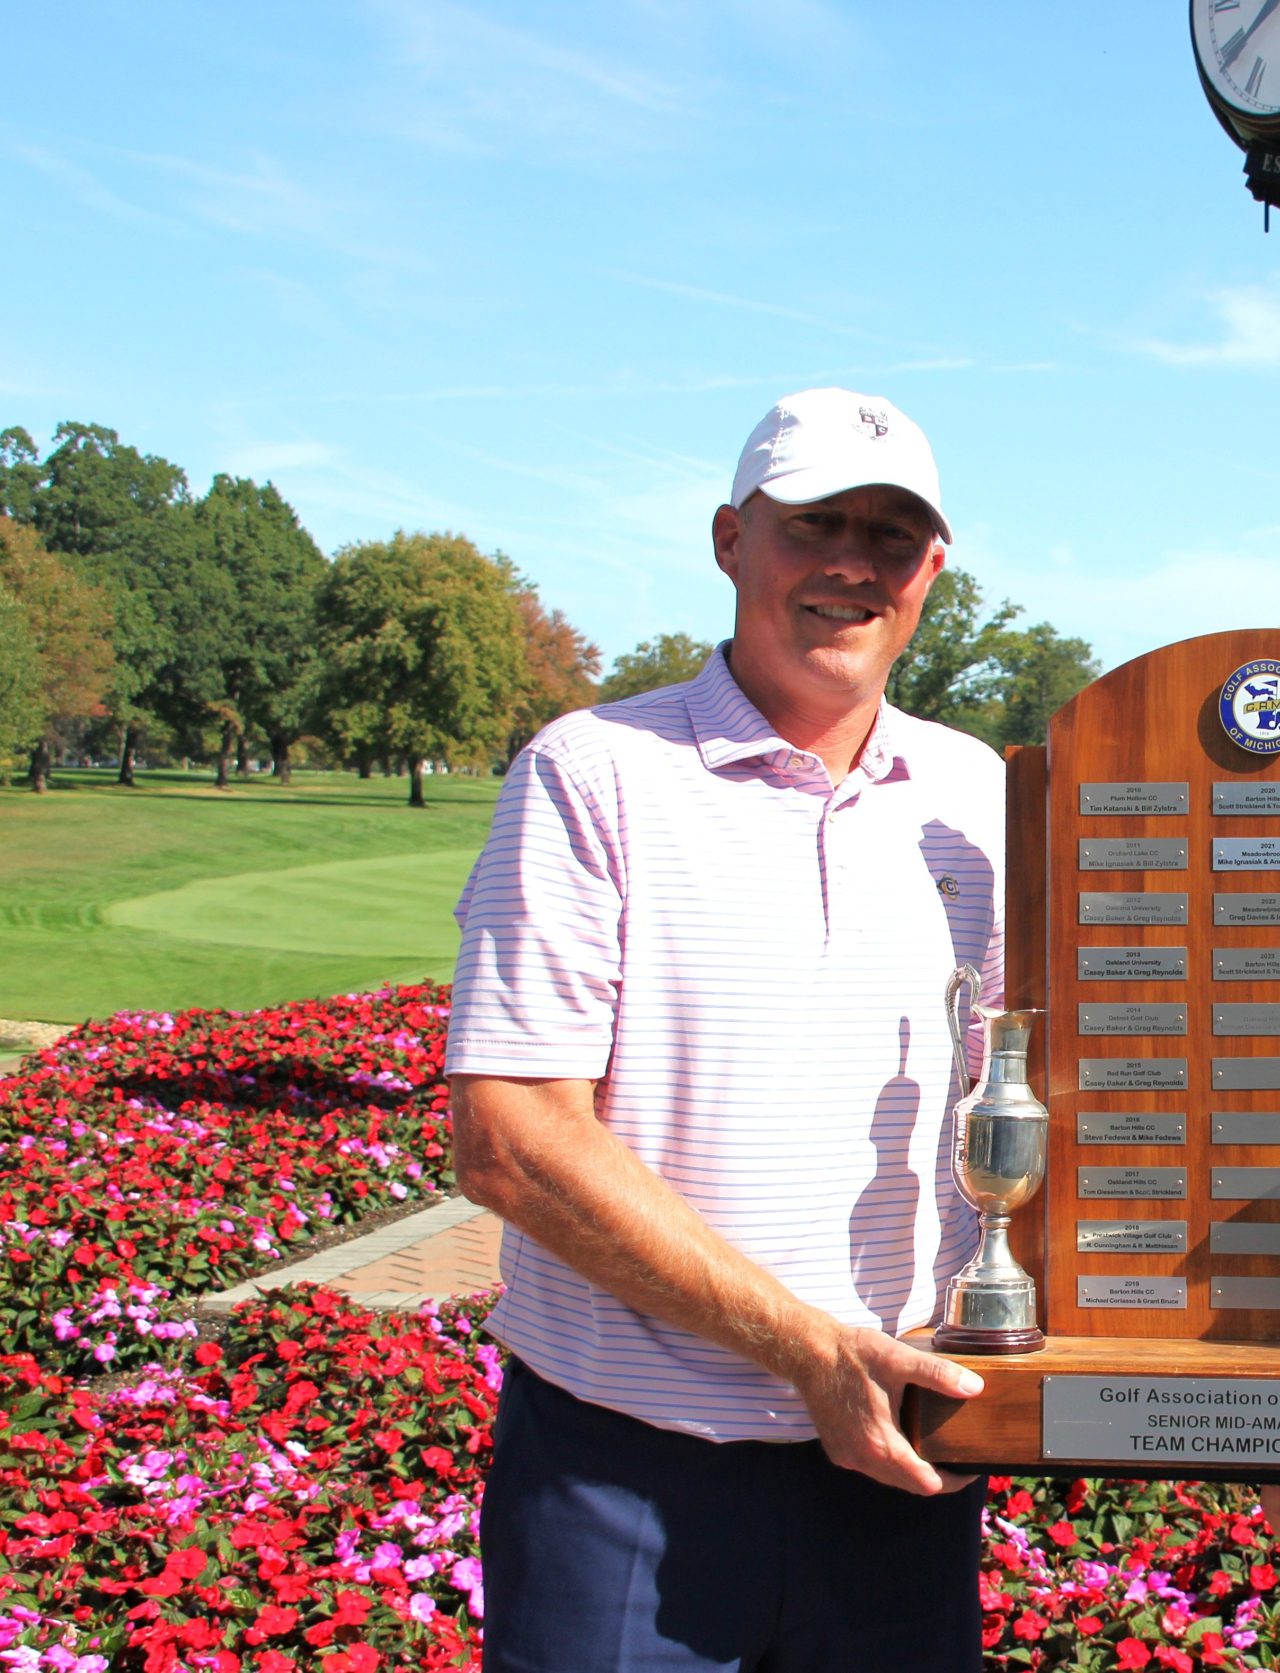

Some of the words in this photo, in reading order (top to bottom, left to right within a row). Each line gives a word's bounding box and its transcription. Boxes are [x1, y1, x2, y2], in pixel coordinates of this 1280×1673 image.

[1224, 674, 1243, 700] GOLF
[1230, 728, 1243, 739] OF
[1229, 914, 1246, 922] Greg
[1084, 969, 1105, 977] Casey
[1134, 969, 1151, 977] Greg
[1152, 969, 1183, 977] Reynolds
[1100, 1387, 1140, 1403] Golf
[1147, 1388, 1262, 1405] Association
[1148, 1414, 1210, 1428] SENIOR
[1130, 1435, 1185, 1451] TEAM
